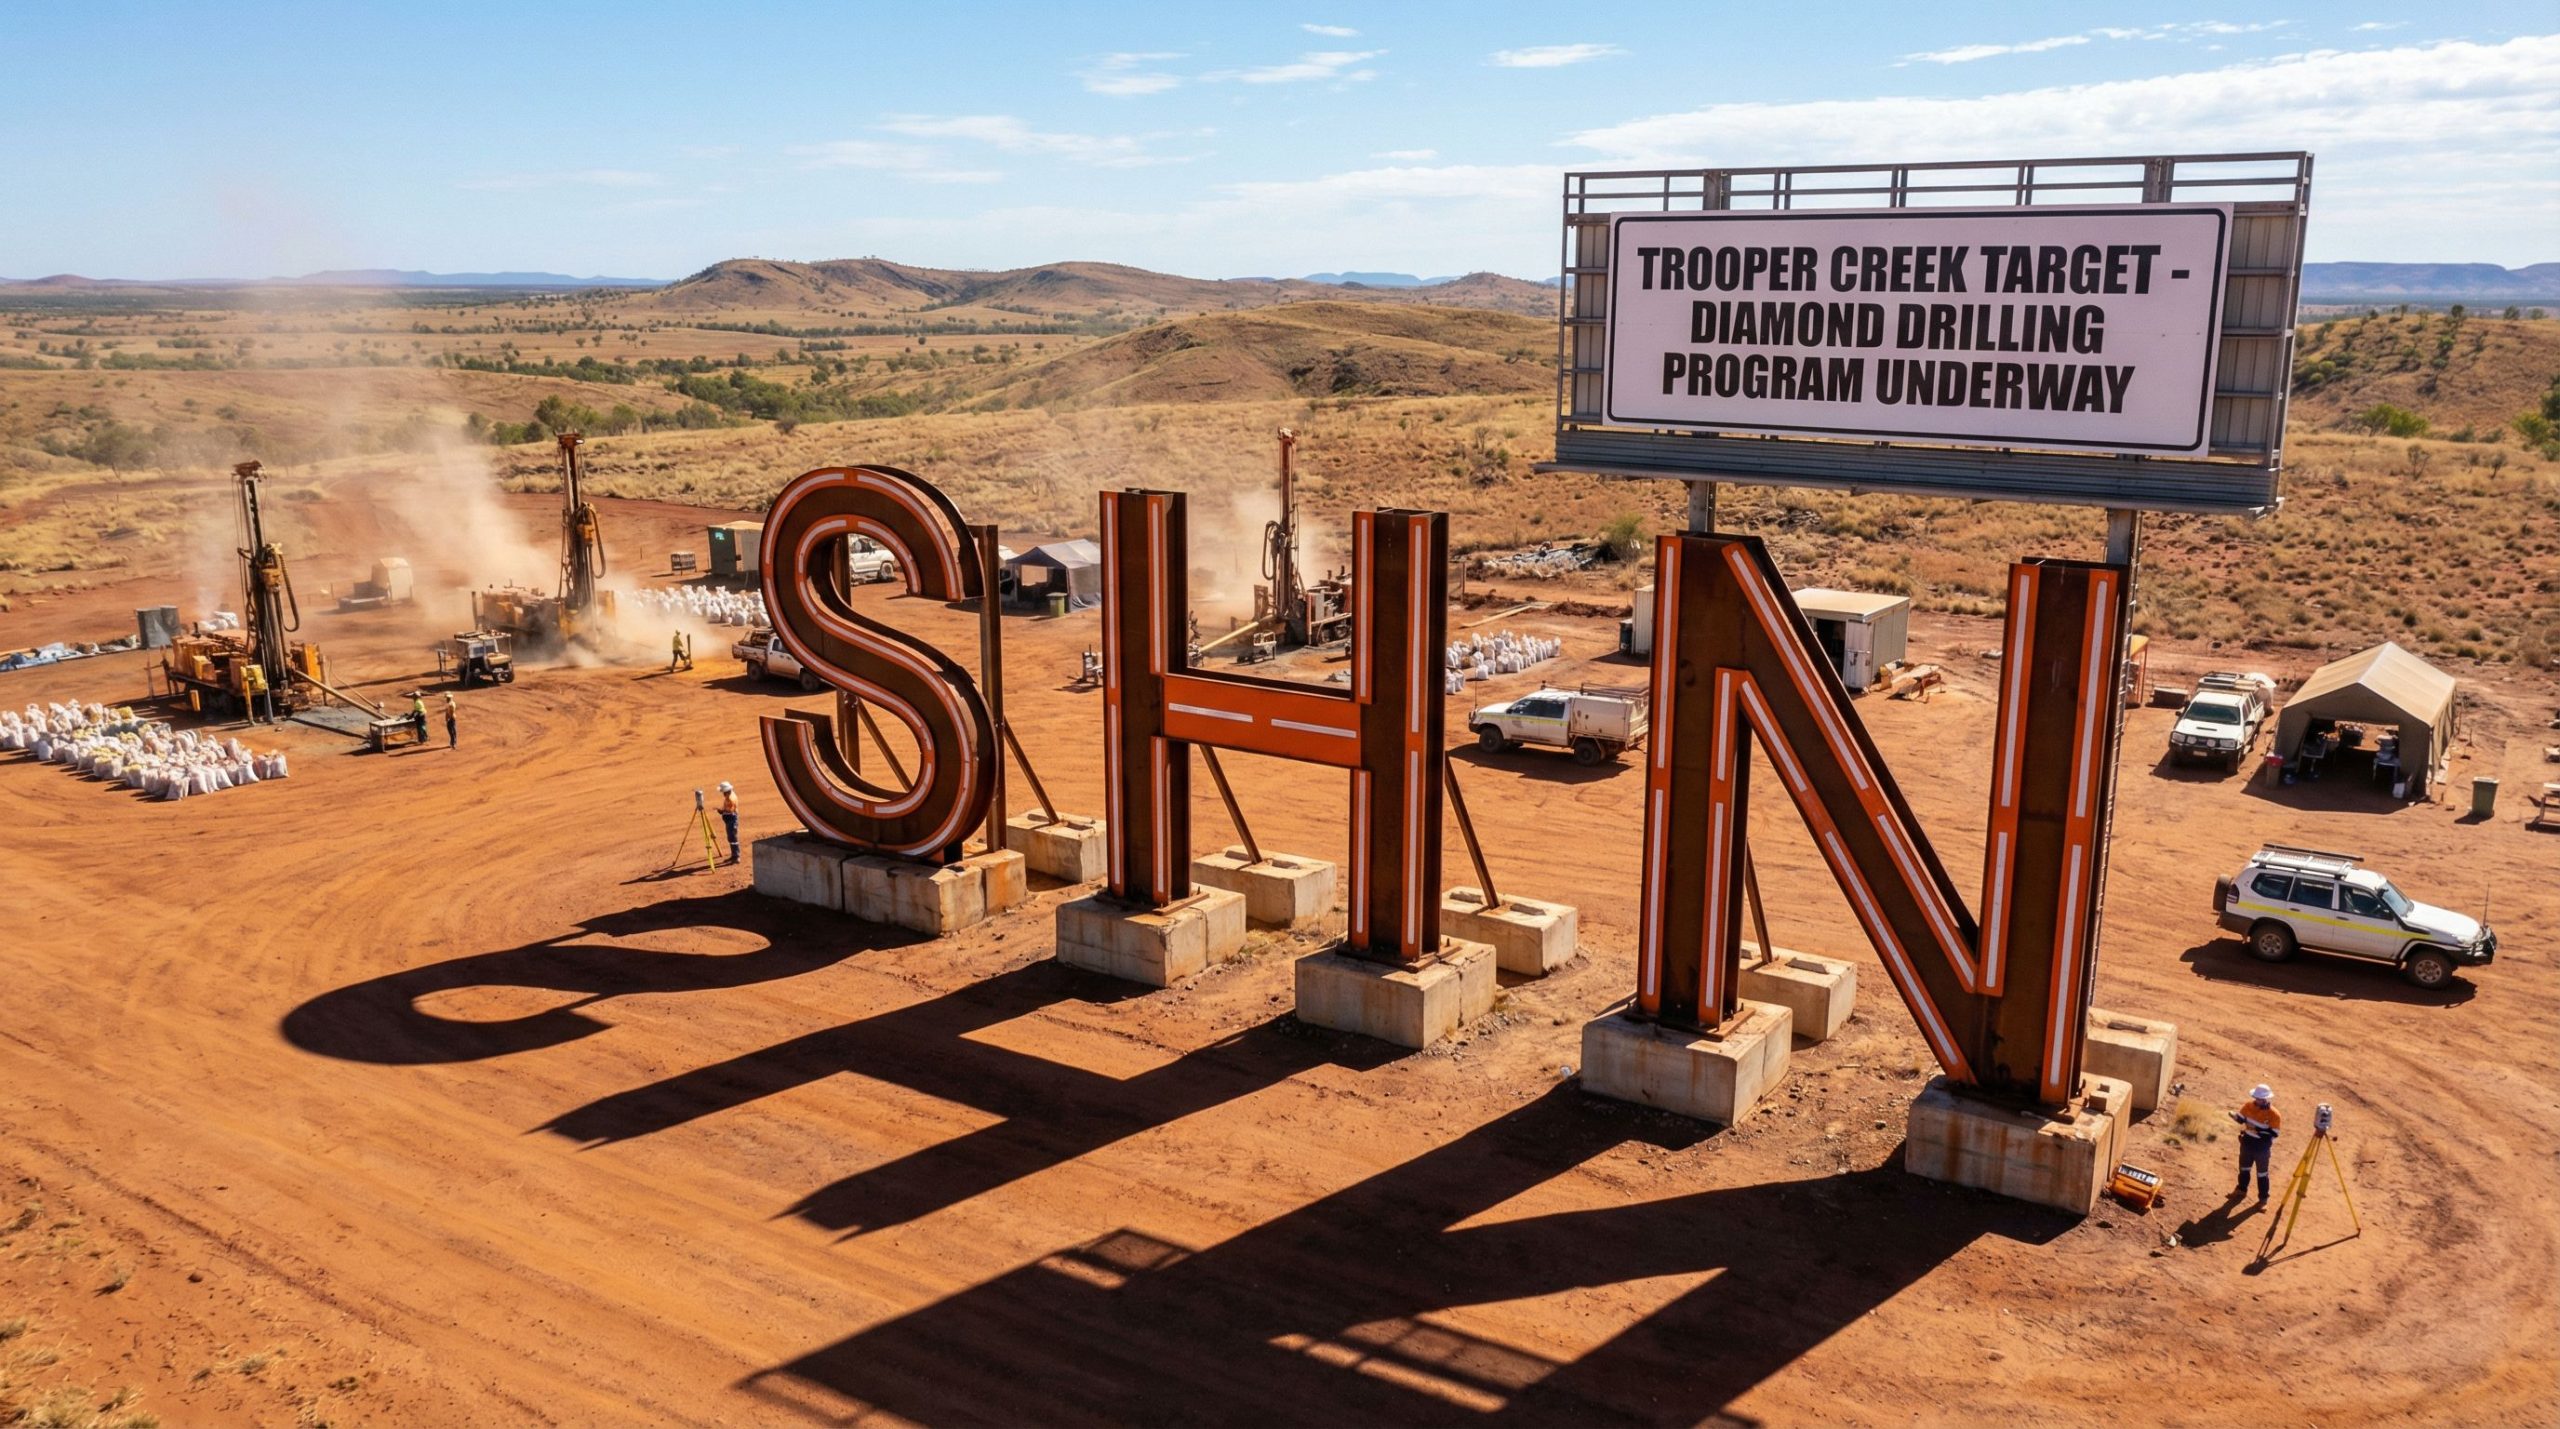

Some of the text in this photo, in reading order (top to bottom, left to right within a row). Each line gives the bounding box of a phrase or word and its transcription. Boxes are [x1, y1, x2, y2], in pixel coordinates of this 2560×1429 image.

[1637, 244, 2191, 295] TROOPER CREEK TARGET -
[1690, 300, 2105, 355] DIAMOND DRILLING
[1662, 351, 2136, 415] PROGRAM UNDERWAY
[758, 464, 2129, 1106] SHN
